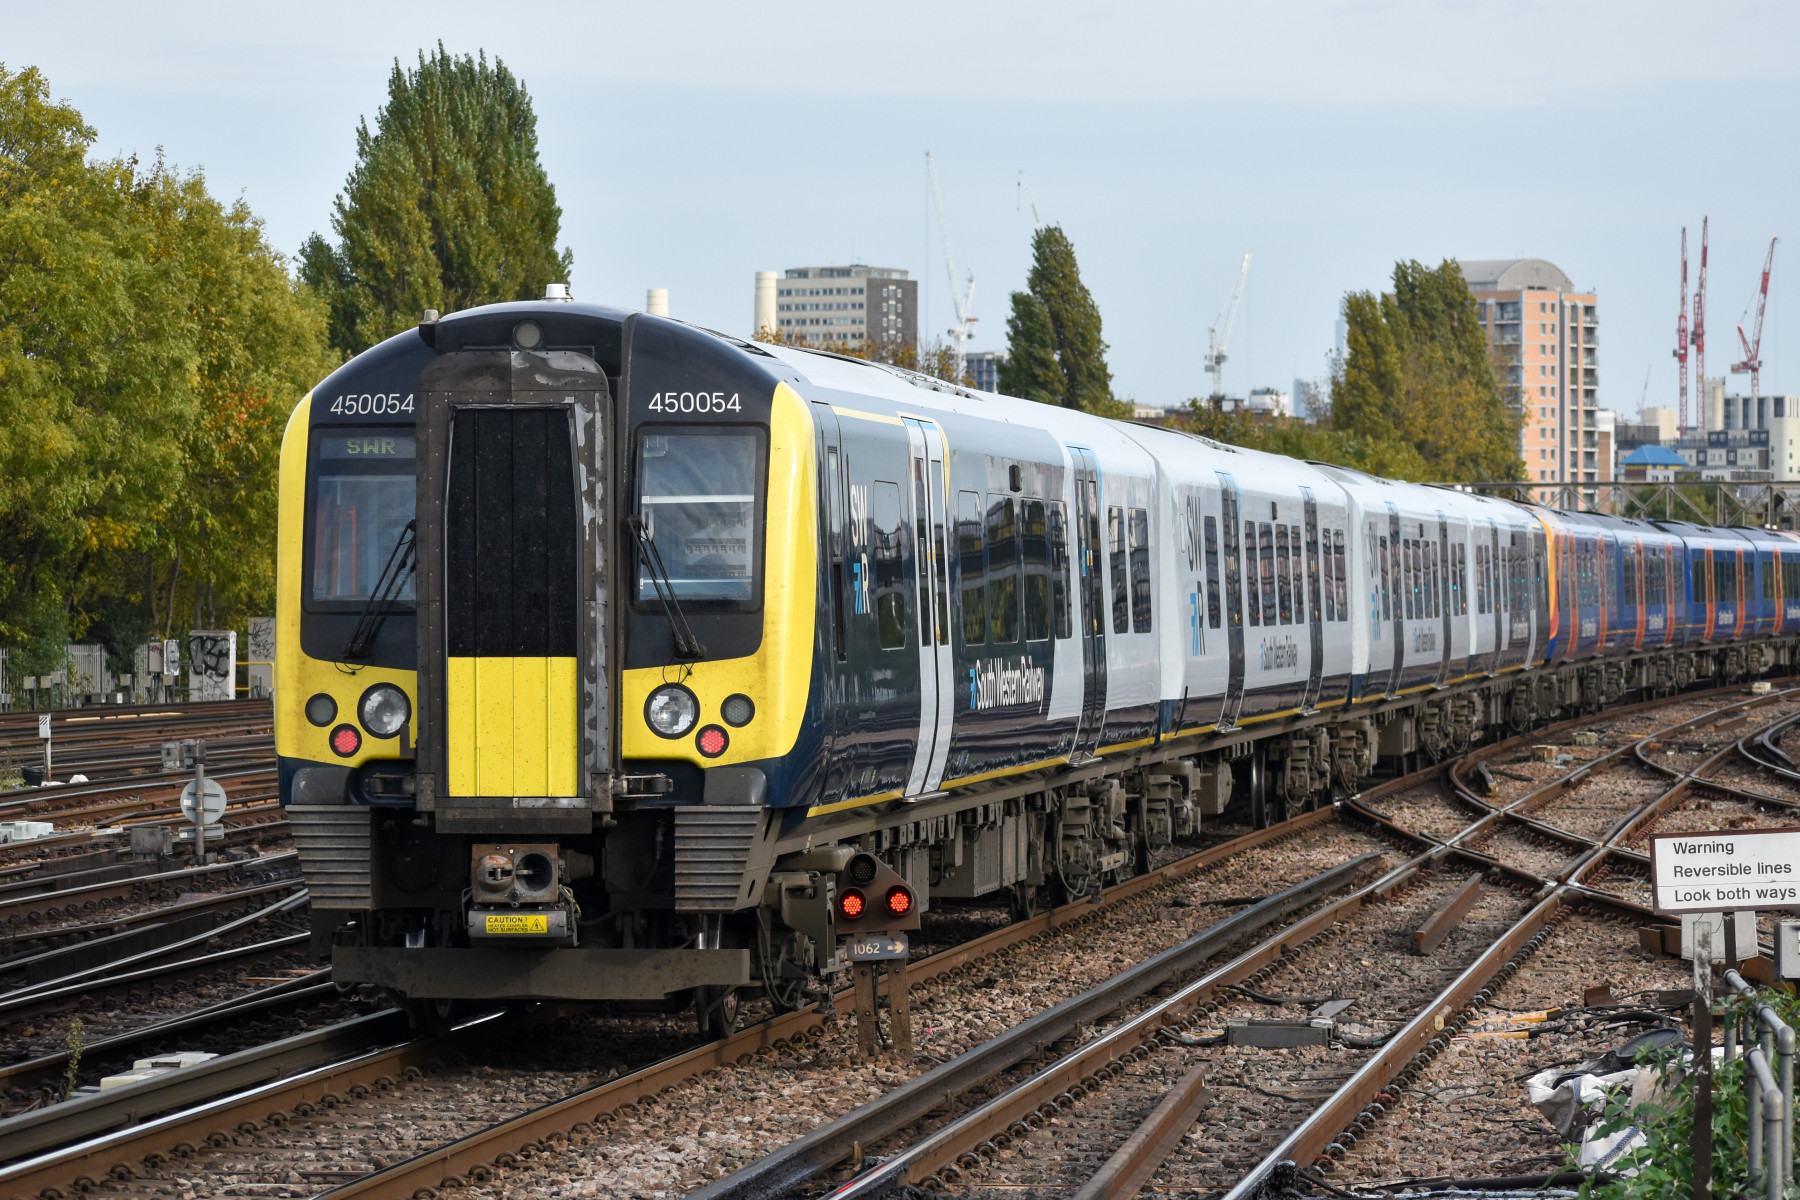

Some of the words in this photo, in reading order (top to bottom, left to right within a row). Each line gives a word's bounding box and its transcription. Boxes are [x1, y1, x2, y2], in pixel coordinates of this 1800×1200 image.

[330, 393, 415, 415] 450054
[648, 392, 742, 413] 450054
[346, 439, 396, 454] SWR
[976, 659, 996, 710] South
[994, 657, 1022, 706] Western
[1021, 655, 1045, 714] Railway
[1673, 841, 1734, 855] Warning
[1674, 863, 1752, 878] Reversible
[1757, 862, 1792, 875] lines
[1675, 889, 1711, 902] Look
[1716, 887, 1751, 900] both
[1756, 888, 1797, 900] ways
[854, 943, 880, 955] 1062
